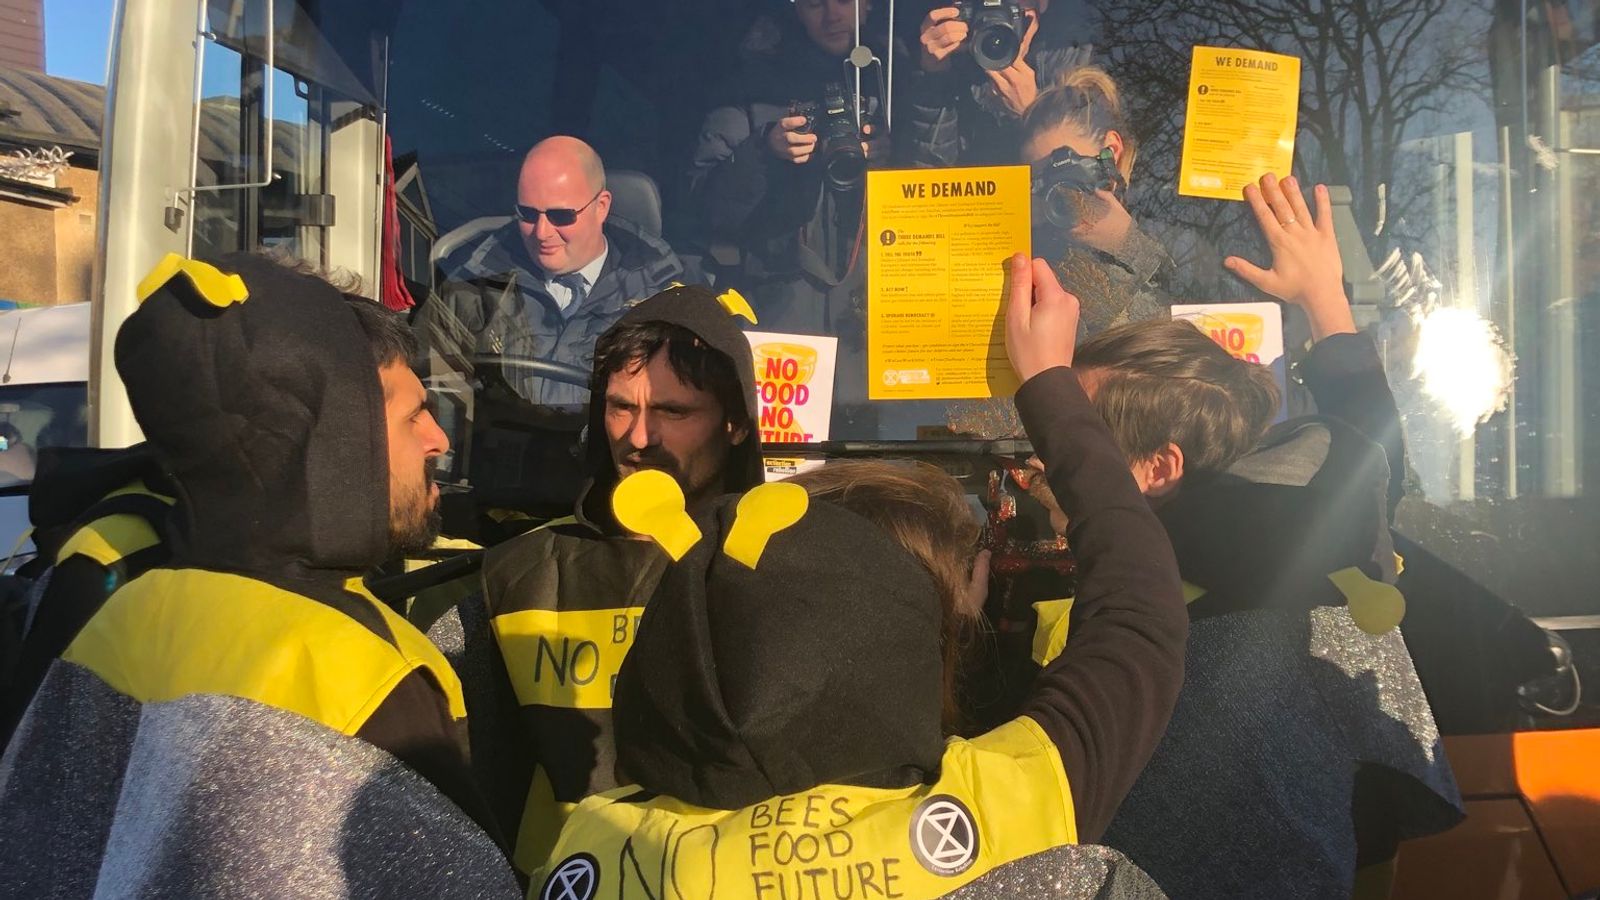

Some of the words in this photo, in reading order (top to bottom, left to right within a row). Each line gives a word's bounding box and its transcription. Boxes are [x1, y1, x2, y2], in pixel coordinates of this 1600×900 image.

[1215, 56, 1232, 67] WE
[1235, 57, 1279, 71] DEMAND
[902, 183, 926, 199] WE
[931, 180, 997, 198] DEMAND
[1211, 328, 1245, 351] NO
[765, 357, 798, 382] NO
[760, 405, 794, 430] NO
[534, 635, 600, 686] NO
[750, 795, 854, 829] BEES
[618, 819, 720, 900] NO
[749, 829, 854, 867] FOOD
[751, 858, 904, 900] FUTURE
